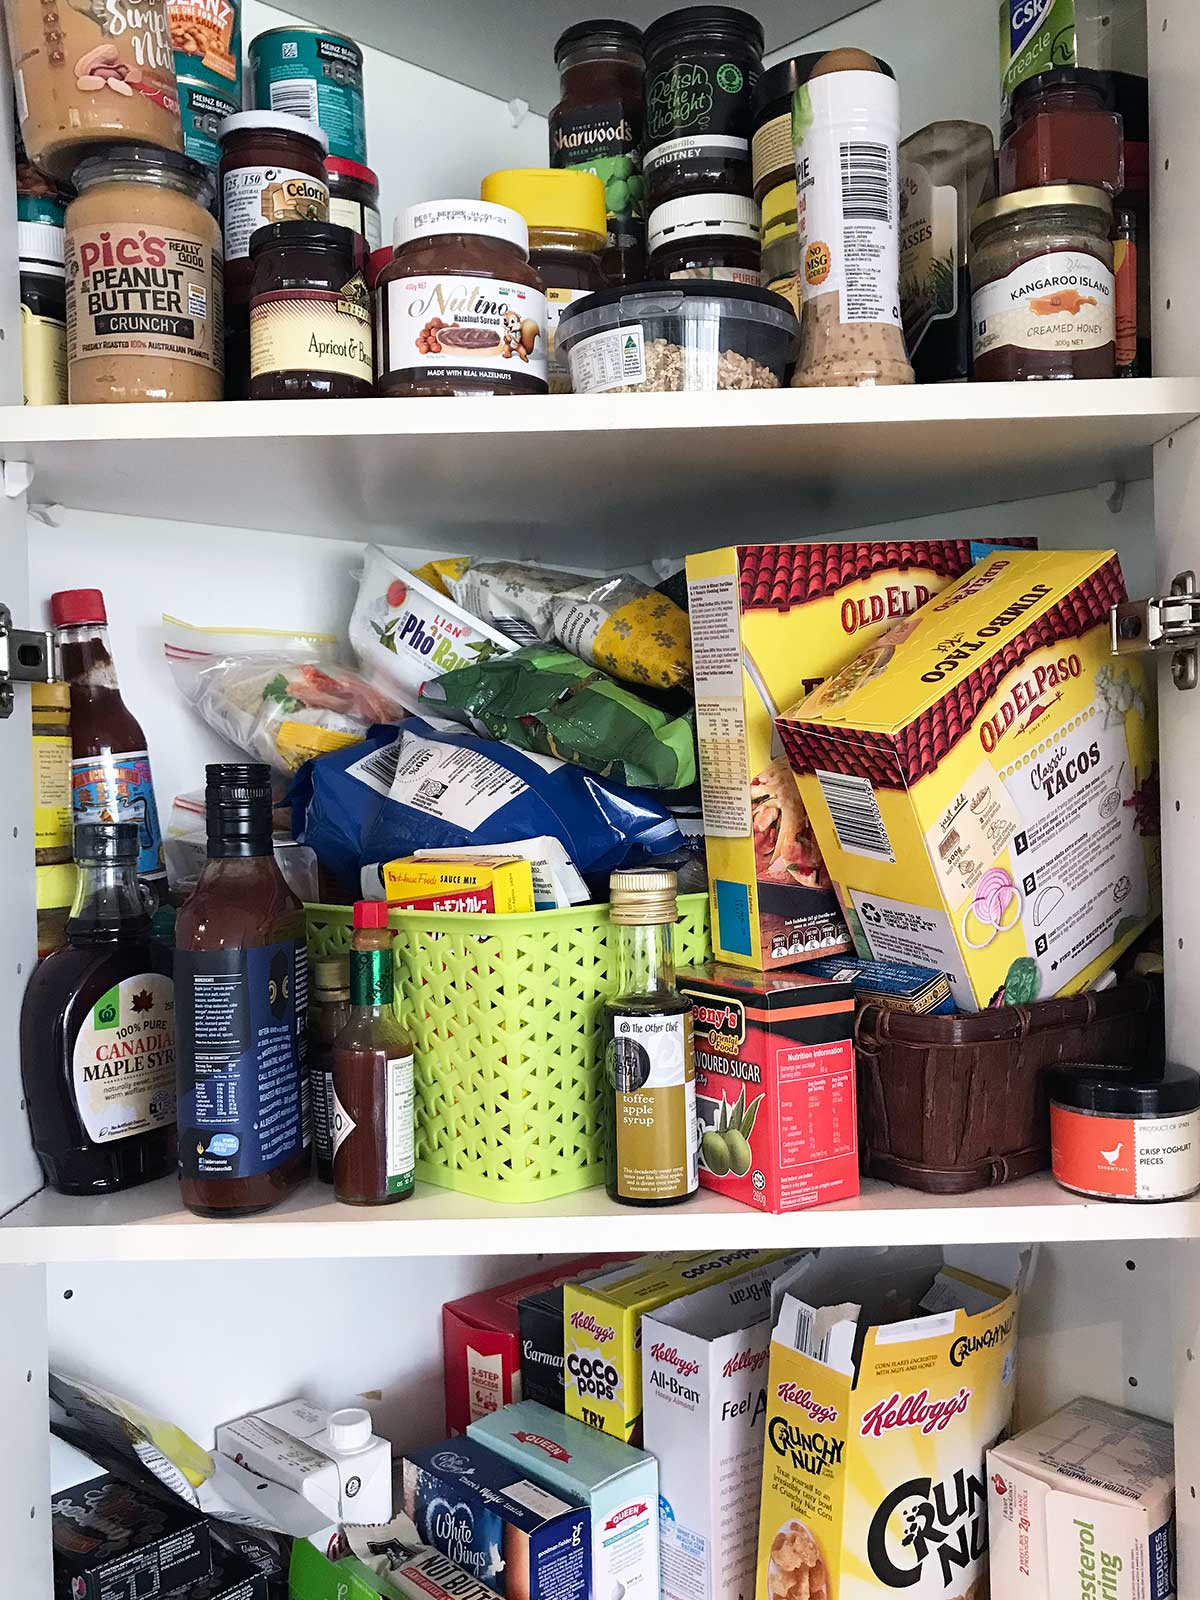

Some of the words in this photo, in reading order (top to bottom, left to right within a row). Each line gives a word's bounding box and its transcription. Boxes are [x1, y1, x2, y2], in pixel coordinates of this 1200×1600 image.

[172, 14, 194, 24] HAM
[1008, 32, 1051, 84] treacle
[651, 64, 702, 104] Relish
[192, 92, 215, 106] HEINZ
[668, 90, 688, 109] the
[652, 94, 706, 133] thought
[658, 139, 695, 153] Tamarillo
[654, 149, 702, 168] CHUTNEY
[243, 174, 261, 185] 150
[168, 242, 200, 256] REALLY
[901, 225, 933, 251] ASSES
[178, 252, 204, 268] GOOD
[809, 246, 821, 256] NO
[806, 254, 828, 271] MSG
[92, 267, 184, 291] PEANUT
[1010, 275, 1077, 300] KANGAROO
[1079, 276, 1110, 296] ISLAND
[88, 289, 183, 316] BUTTER
[408, 283, 508, 318] Nutino
[109, 317, 180, 334] CRUNCHY
[454, 314, 479, 324] Hazelnut
[480, 316, 500, 326] Spread
[1026, 324, 1074, 337] CREAMED
[1076, 324, 1103, 335] HONEY
[103, 341, 129, 350] ROASTED
[130, 340, 147, 349] 100%
[148, 342, 187, 355] AUSTRALIAN
[308, 332, 347, 358] Apricot
[348, 338, 358, 359] &
[427, 369, 444, 377] MADE
[446, 369, 462, 377] WITH
[479, 370, 512, 381] HAZELNUTS
[976, 584, 1053, 637] JUMBO
[434, 614, 462, 639] LIAN
[921, 640, 986, 683] TACO
[408, 752, 434, 776] 100%
[1029, 744, 1067, 791] Classic
[1041, 741, 1101, 801] TACOS
[939, 811, 954, 834] just
[953, 793, 967, 810] add
[418, 872, 437, 885] Foods
[439, 875, 461, 885] SAUCE
[463, 876, 477, 885] MIX
[115, 1021, 142, 1040] 100%
[143, 1020, 169, 1031] PURE
[632, 1023, 643, 1033] The
[645, 1023, 663, 1033] Other
[666, 1021, 679, 1033] Chef
[708, 1031, 739, 1046] Oriental
[716, 1042, 739, 1055] Foods
[788, 1051, 813, 1063] Nutrition
[813, 1047, 844, 1058] Information
[82, 1055, 145, 1082] MAPLE
[730, 1057, 761, 1084] SUGAR
[103, 1082, 133, 1094] naturally
[104, 1091, 124, 1101] warm
[124, 1086, 146, 1098] waffles
[623, 1093, 655, 1103] toffee
[623, 1104, 653, 1116] apple
[623, 1116, 655, 1127] syrup
[1139, 1124, 1169, 1132] PRODUCT
[1139, 1148, 1161, 1156] CRISP
[1161, 1142, 1192, 1155] YOGHURT
[1139, 1158, 1164, 1166] PIECES
[570, 1311, 615, 1343] Kellogg's
[523, 1340, 565, 1368] Carman
[650, 1343, 699, 1377] Kellogg's
[874, 1360, 890, 1370] CORN
[891, 1358, 910, 1368] FLAKES
[910, 1354, 938, 1365] ENCRUSTED
[471, 1367, 500, 1381] 3-STEP
[876, 1368, 890, 1376] WITH
[890, 1367, 905, 1375] NUTS
[905, 1365, 918, 1373] AND
[918, 1361, 936, 1372] HONEY
[472, 1377, 499, 1390] PROCESS
[577, 1376, 615, 1401] pops
[650, 1370, 700, 1404] All-Bran
[722, 1392, 752, 1421] Feel
[778, 1382, 838, 1423] Kellogg's
[861, 1388, 971, 1437] Kellogg's
[581, 1407, 606, 1429] TRY
[525, 1433, 564, 1456] QUEEN
[768, 1416, 845, 1465] CRUNCHY
[791, 1449, 828, 1476] NUT
[776, 1465, 790, 1478] Treat
[791, 1474, 814, 1492] yourself
[814, 1488, 822, 1497] to
[1056, 1466, 1104, 1488] INFORMATION
[771, 1483, 778, 1491] of
[779, 1486, 803, 1505] Crunchy
[804, 1501, 815, 1512] Nut
[817, 1507, 833, 1522] Corn
[802, 1489, 817, 1503] tasty
[818, 1497, 833, 1512] bowl
[1103, 1482, 1142, 1501] NUTRITION
[612, 1505, 640, 1524] QUEEN
[1018, 1518, 1031, 1532] 2g
[436, 1512, 473, 1544] White
[867, 1468, 988, 1589] CRUN
[448, 1538, 486, 1578] Wings
[936, 1516, 990, 1589] NU
[1073, 1518, 1097, 1600] esterol
[1019, 1565, 1030, 1577] 2
[1100, 1551, 1123, 1600] ring
[1154, 1532, 1165, 1597] REDUCES
[416, 1554, 462, 1581] NUT
[441, 1574, 503, 1600] BUT
